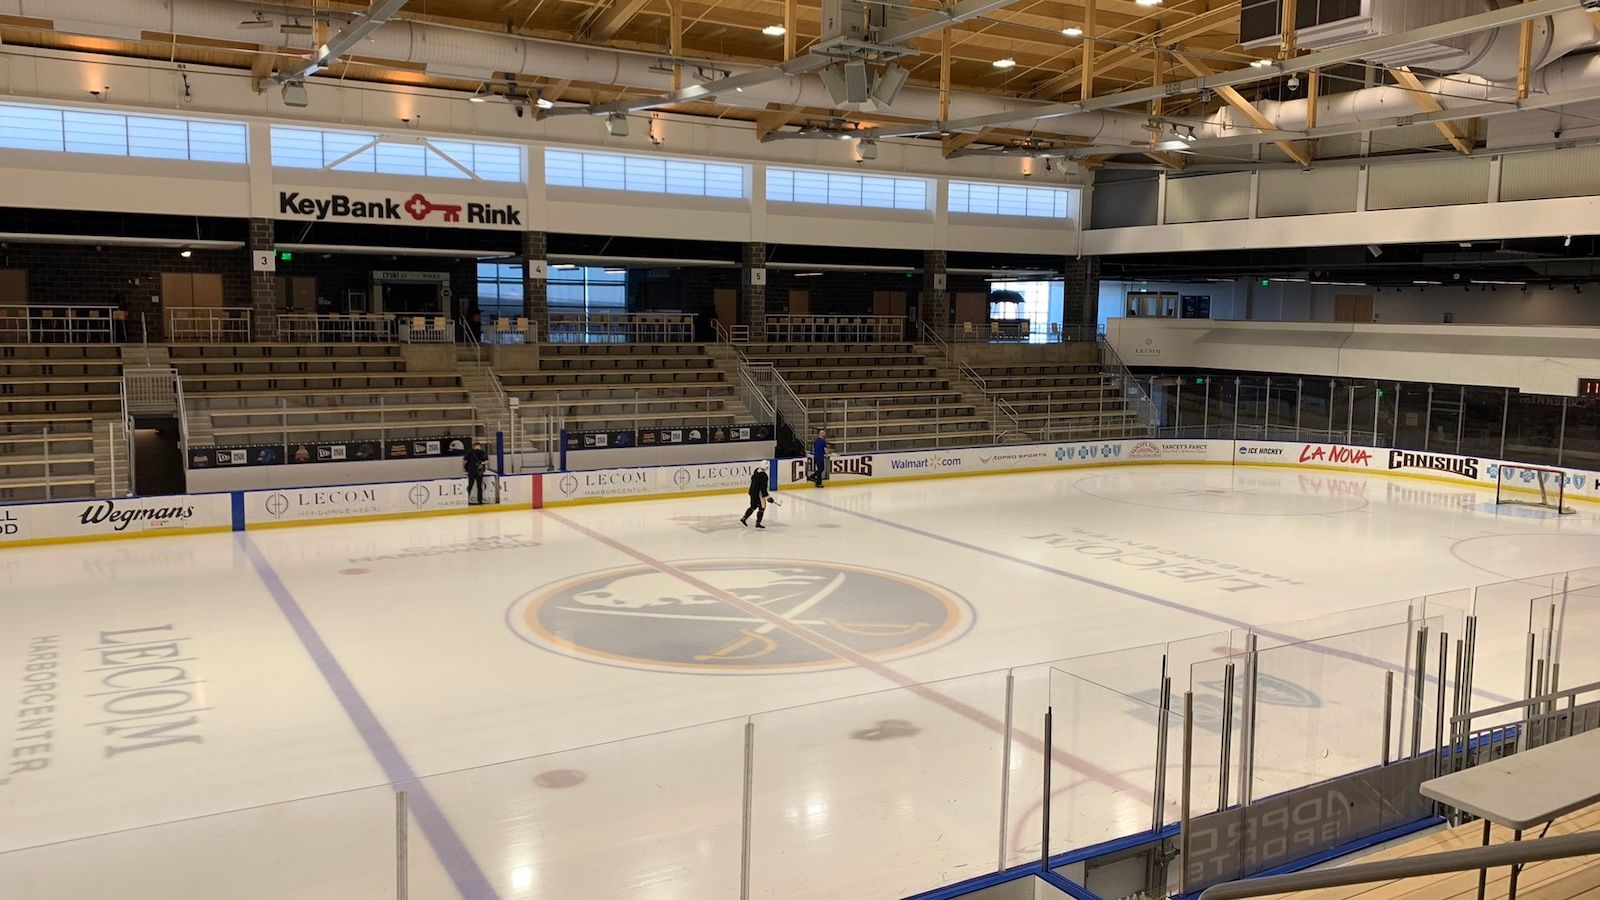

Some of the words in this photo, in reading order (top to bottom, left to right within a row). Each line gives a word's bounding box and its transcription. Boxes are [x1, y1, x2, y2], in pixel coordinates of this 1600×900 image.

[279, 192, 401, 220] KeyBank
[467, 202, 522, 225] Rink
[261, 256, 268, 265] 3
[756, 272, 761, 280] 5
[891, 458, 928, 470] Walmart
[941, 457, 961, 467] com
[1299, 445, 1326, 463] LA
[1329, 445, 1373, 467] NOVA
[1388, 450, 1479, 480] CANISIUS
[585, 471, 647, 487] LECOM
[697, 461, 752, 479] LECOM
[298, 489, 376, 506] LECOM
[77, 500, 195, 531] Wegmans
[98, 624, 204, 759] LECOM
[8, 635, 59, 775] HARBORCENTER
